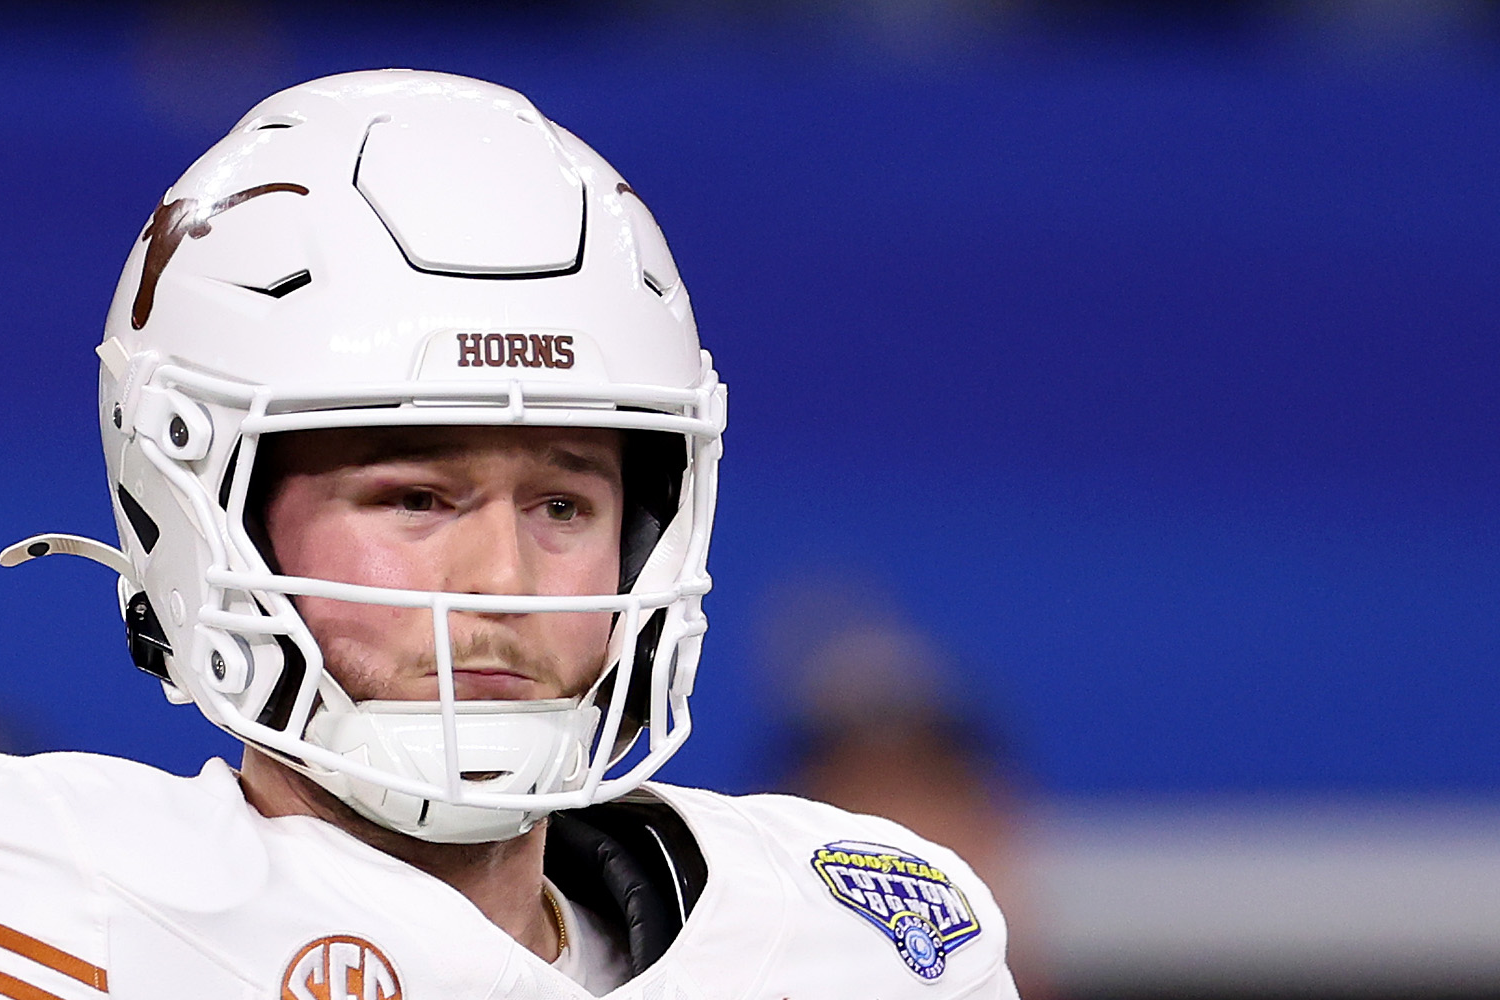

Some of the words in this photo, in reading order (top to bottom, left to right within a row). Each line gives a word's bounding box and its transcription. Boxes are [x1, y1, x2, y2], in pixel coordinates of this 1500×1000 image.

[457, 333, 575, 369] HORNS
[818, 850, 950, 883] GOODYEAR
[824, 865, 970, 926] COTTON
[864, 891, 951, 931] BOWL
[895, 917, 943, 949] CLASSIC
